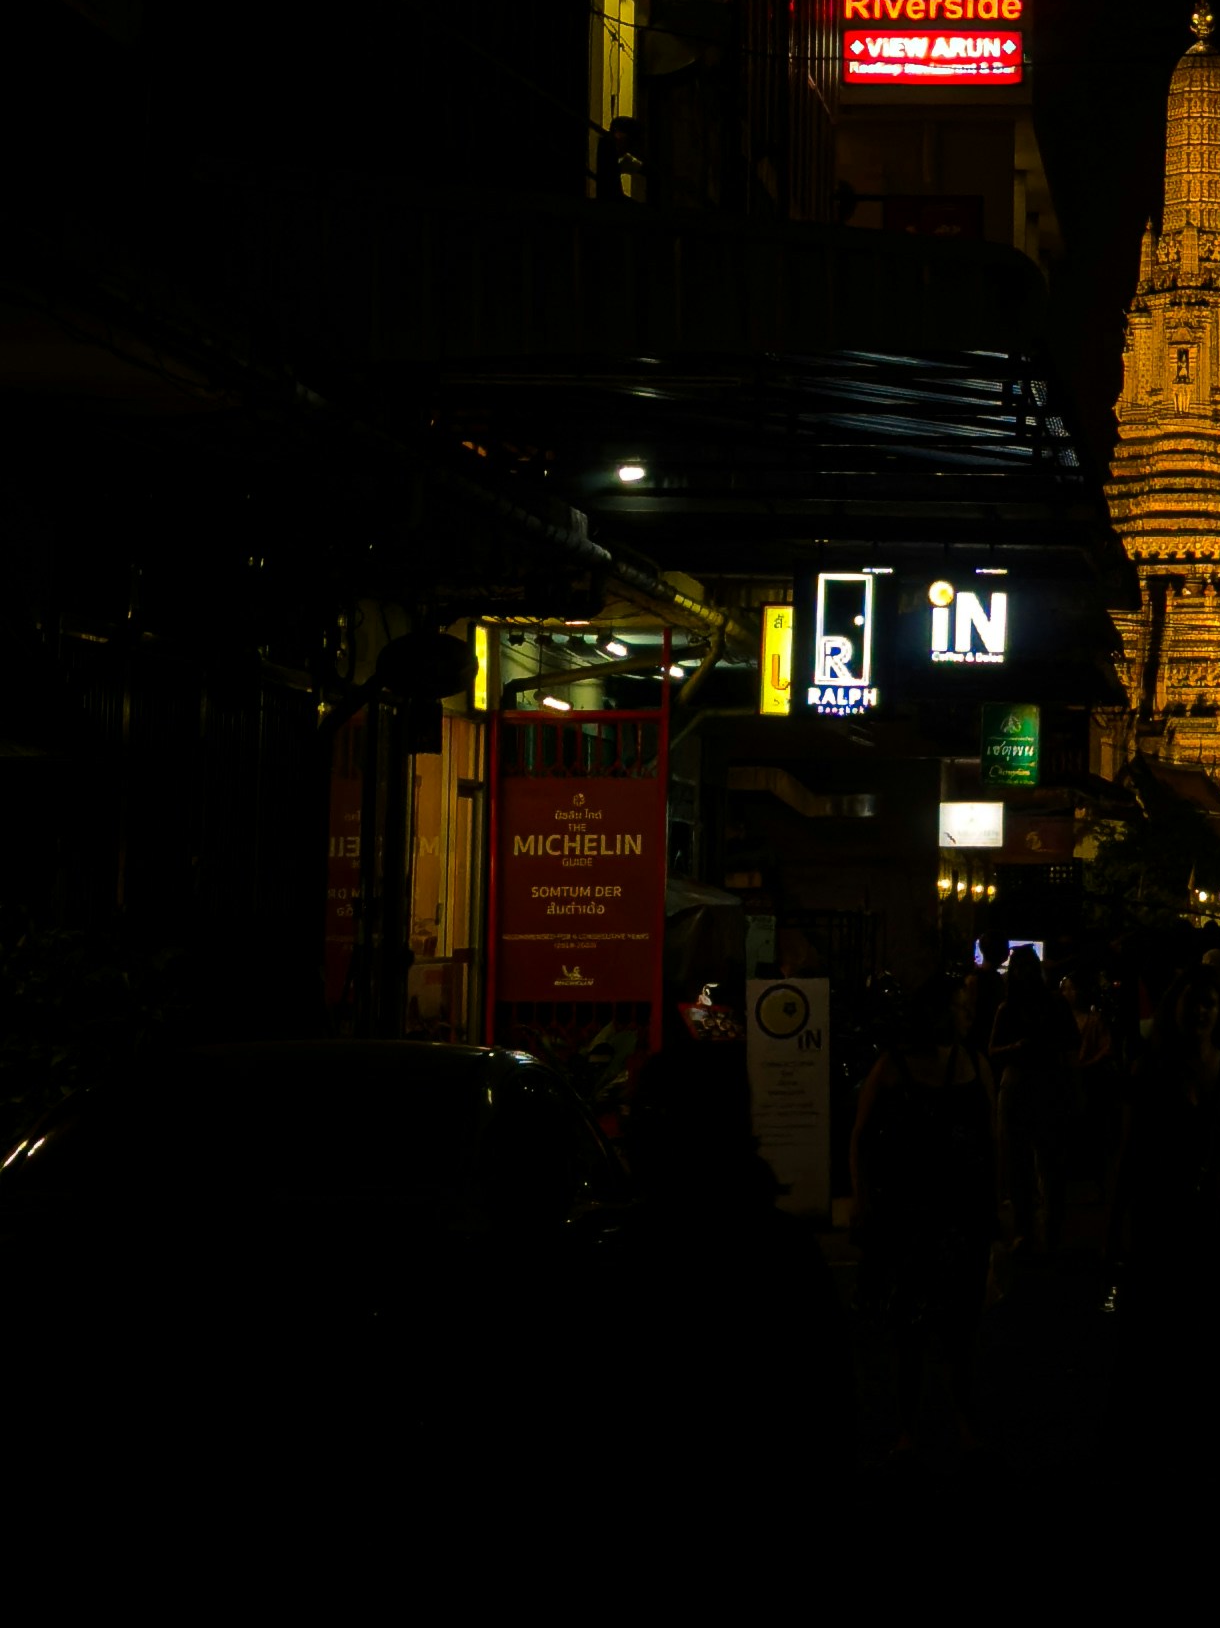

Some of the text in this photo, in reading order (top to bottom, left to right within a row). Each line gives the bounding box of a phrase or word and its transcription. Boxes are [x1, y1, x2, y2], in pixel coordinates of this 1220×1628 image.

[865, 37, 1001, 58] VIEW ARUN
[808, 687, 878, 706] RALPH
[568, 823, 587, 832] THE
[513, 834, 642, 856] MICHELIN
[562, 857, 593, 867] GUIDE
[531, 885, 622, 898] SOMTUM DER
